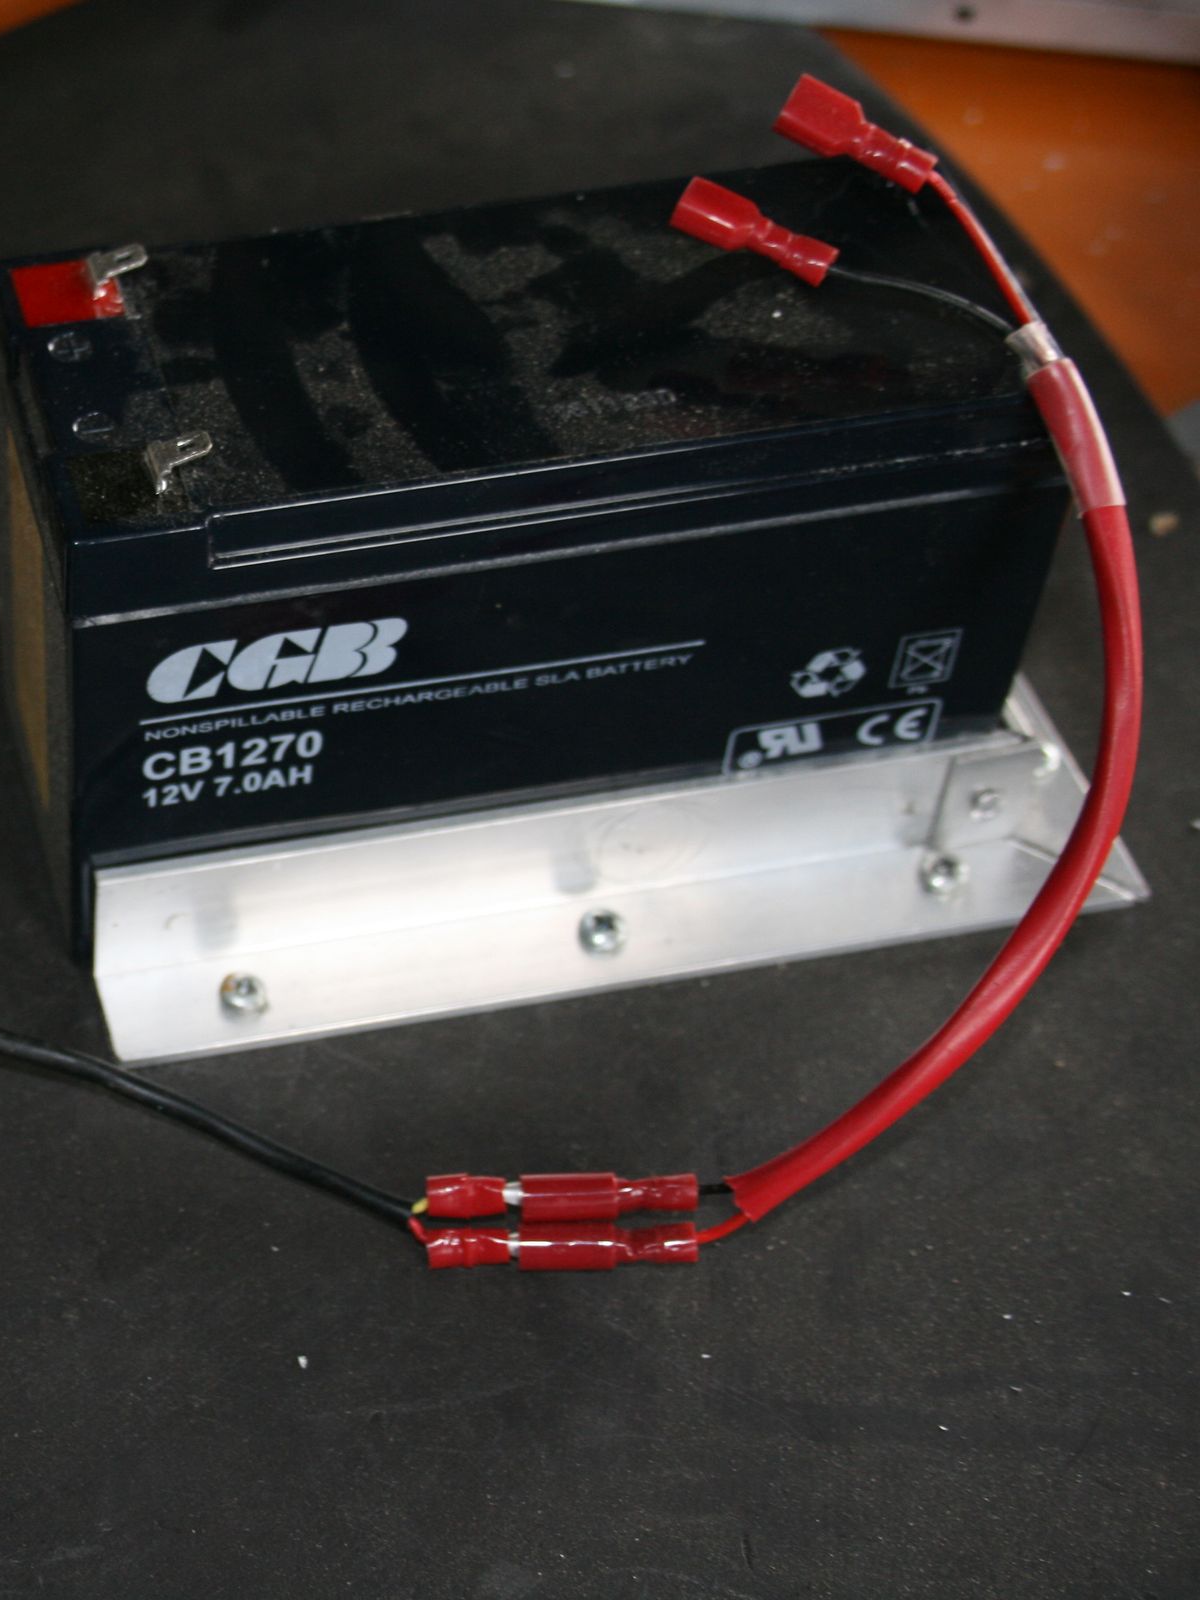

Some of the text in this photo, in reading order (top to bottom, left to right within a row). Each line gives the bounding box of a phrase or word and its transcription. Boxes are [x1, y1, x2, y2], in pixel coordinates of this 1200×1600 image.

[144, 654, 693, 742] NONSPILLABLE RECHARGEABLE SLA BATTERY
[142, 730, 324, 780] CB1270
[142, 764, 314, 808] 12V 7.0AH
